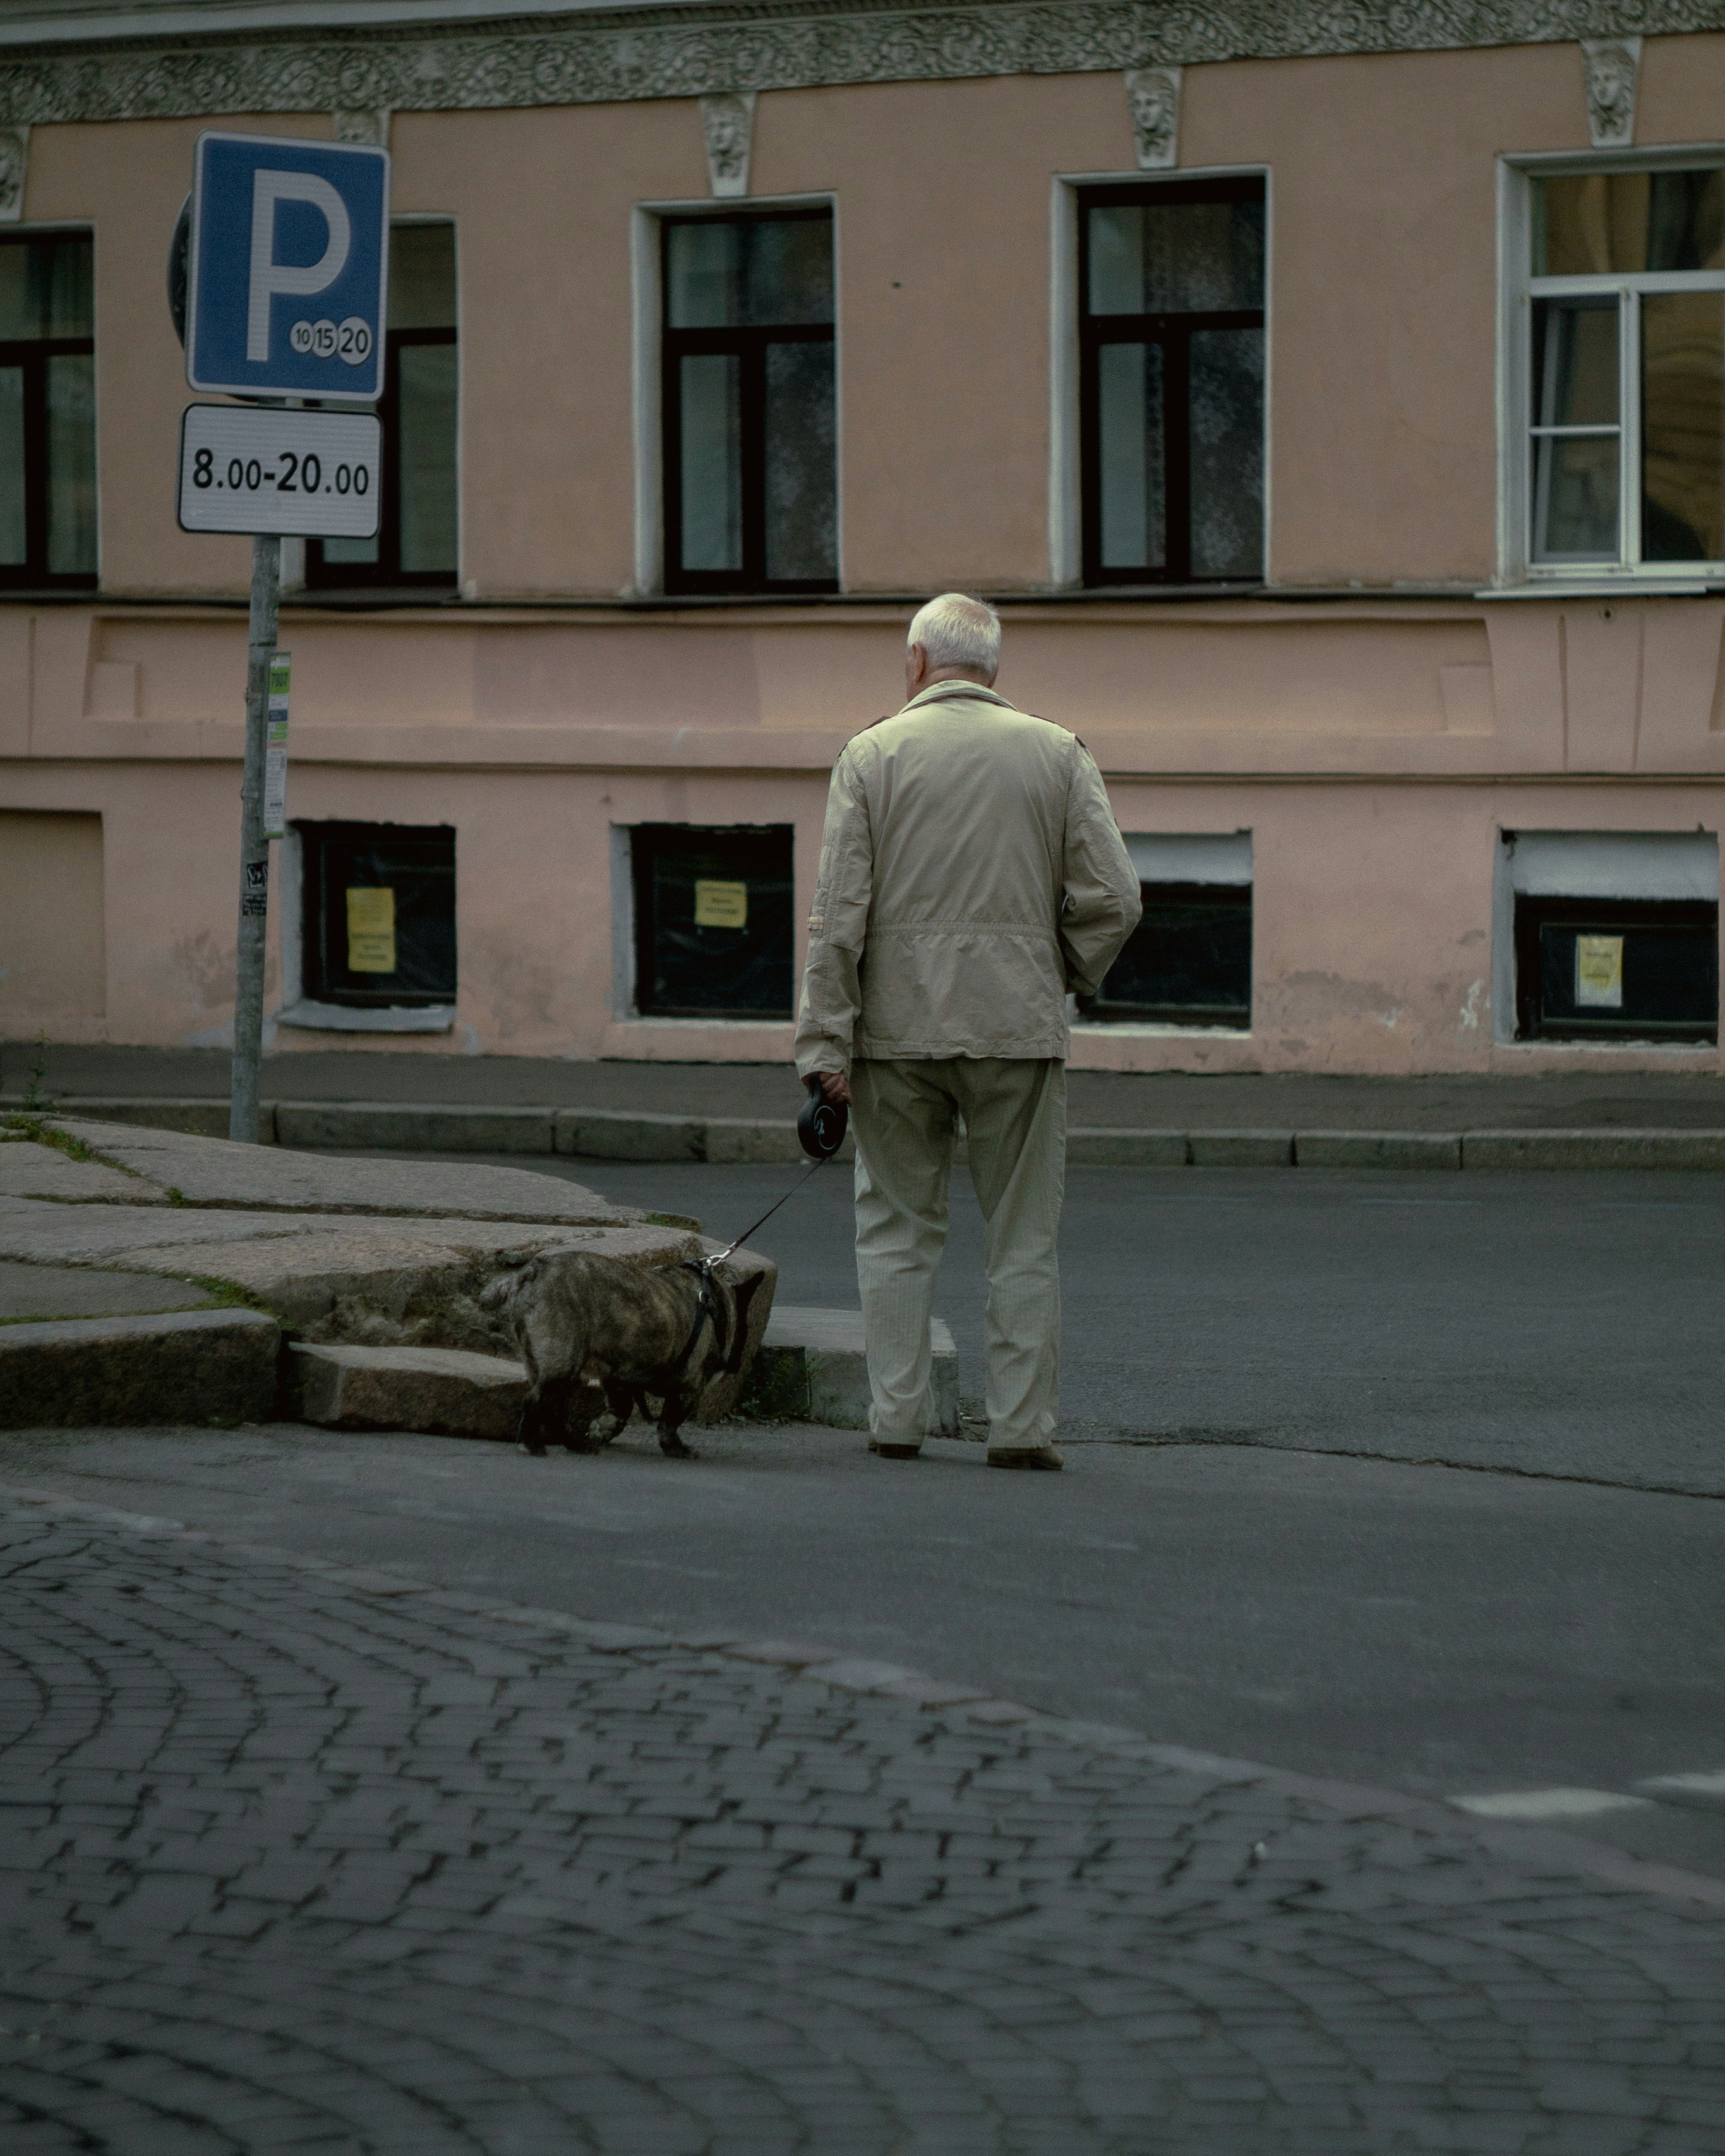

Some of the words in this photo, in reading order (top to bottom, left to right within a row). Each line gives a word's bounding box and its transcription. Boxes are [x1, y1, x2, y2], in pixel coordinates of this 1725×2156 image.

[247, 168, 351, 362] P
[296, 328, 310, 345] 10
[316, 327, 334, 349] 15
[342, 326, 368, 353] 20
[193, 447, 369, 495] 8.00-20.00
